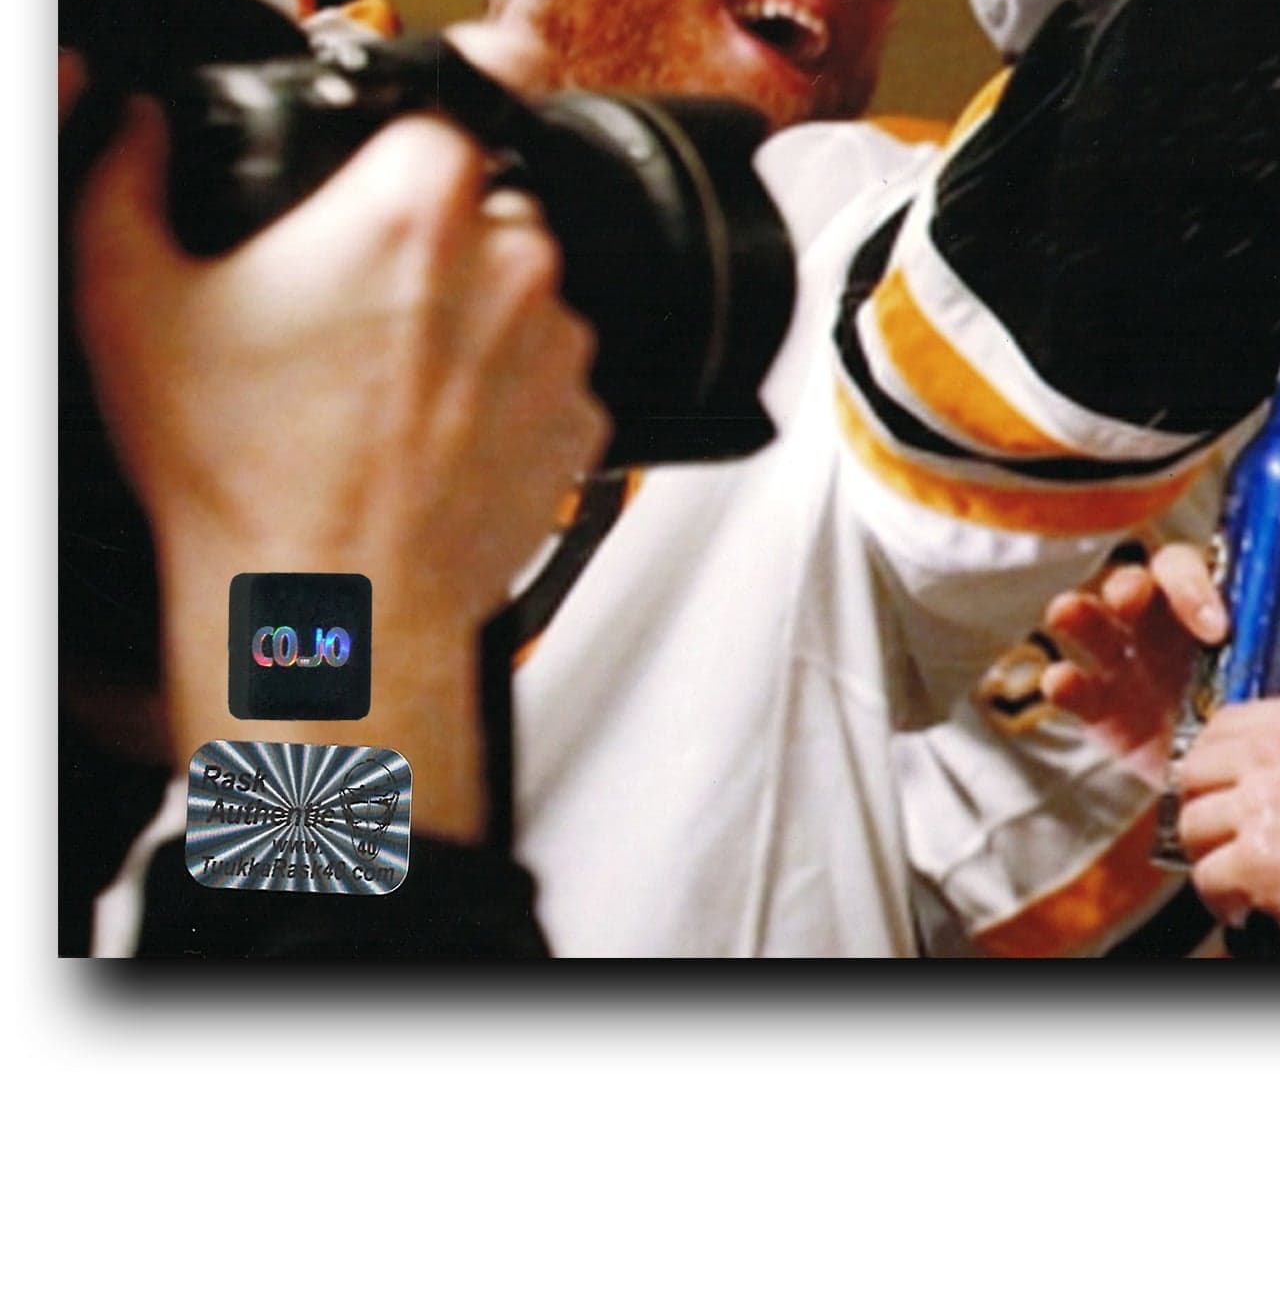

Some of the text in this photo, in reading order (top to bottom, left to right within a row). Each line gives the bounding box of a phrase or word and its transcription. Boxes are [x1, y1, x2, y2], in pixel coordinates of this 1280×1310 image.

[251, 625, 351, 667] COJO
[203, 765, 268, 792] Rask
[205, 797, 336, 828] Authentic
[272, 840, 322, 855] www.
[202, 855, 395, 882] TuukkaRask40.com
